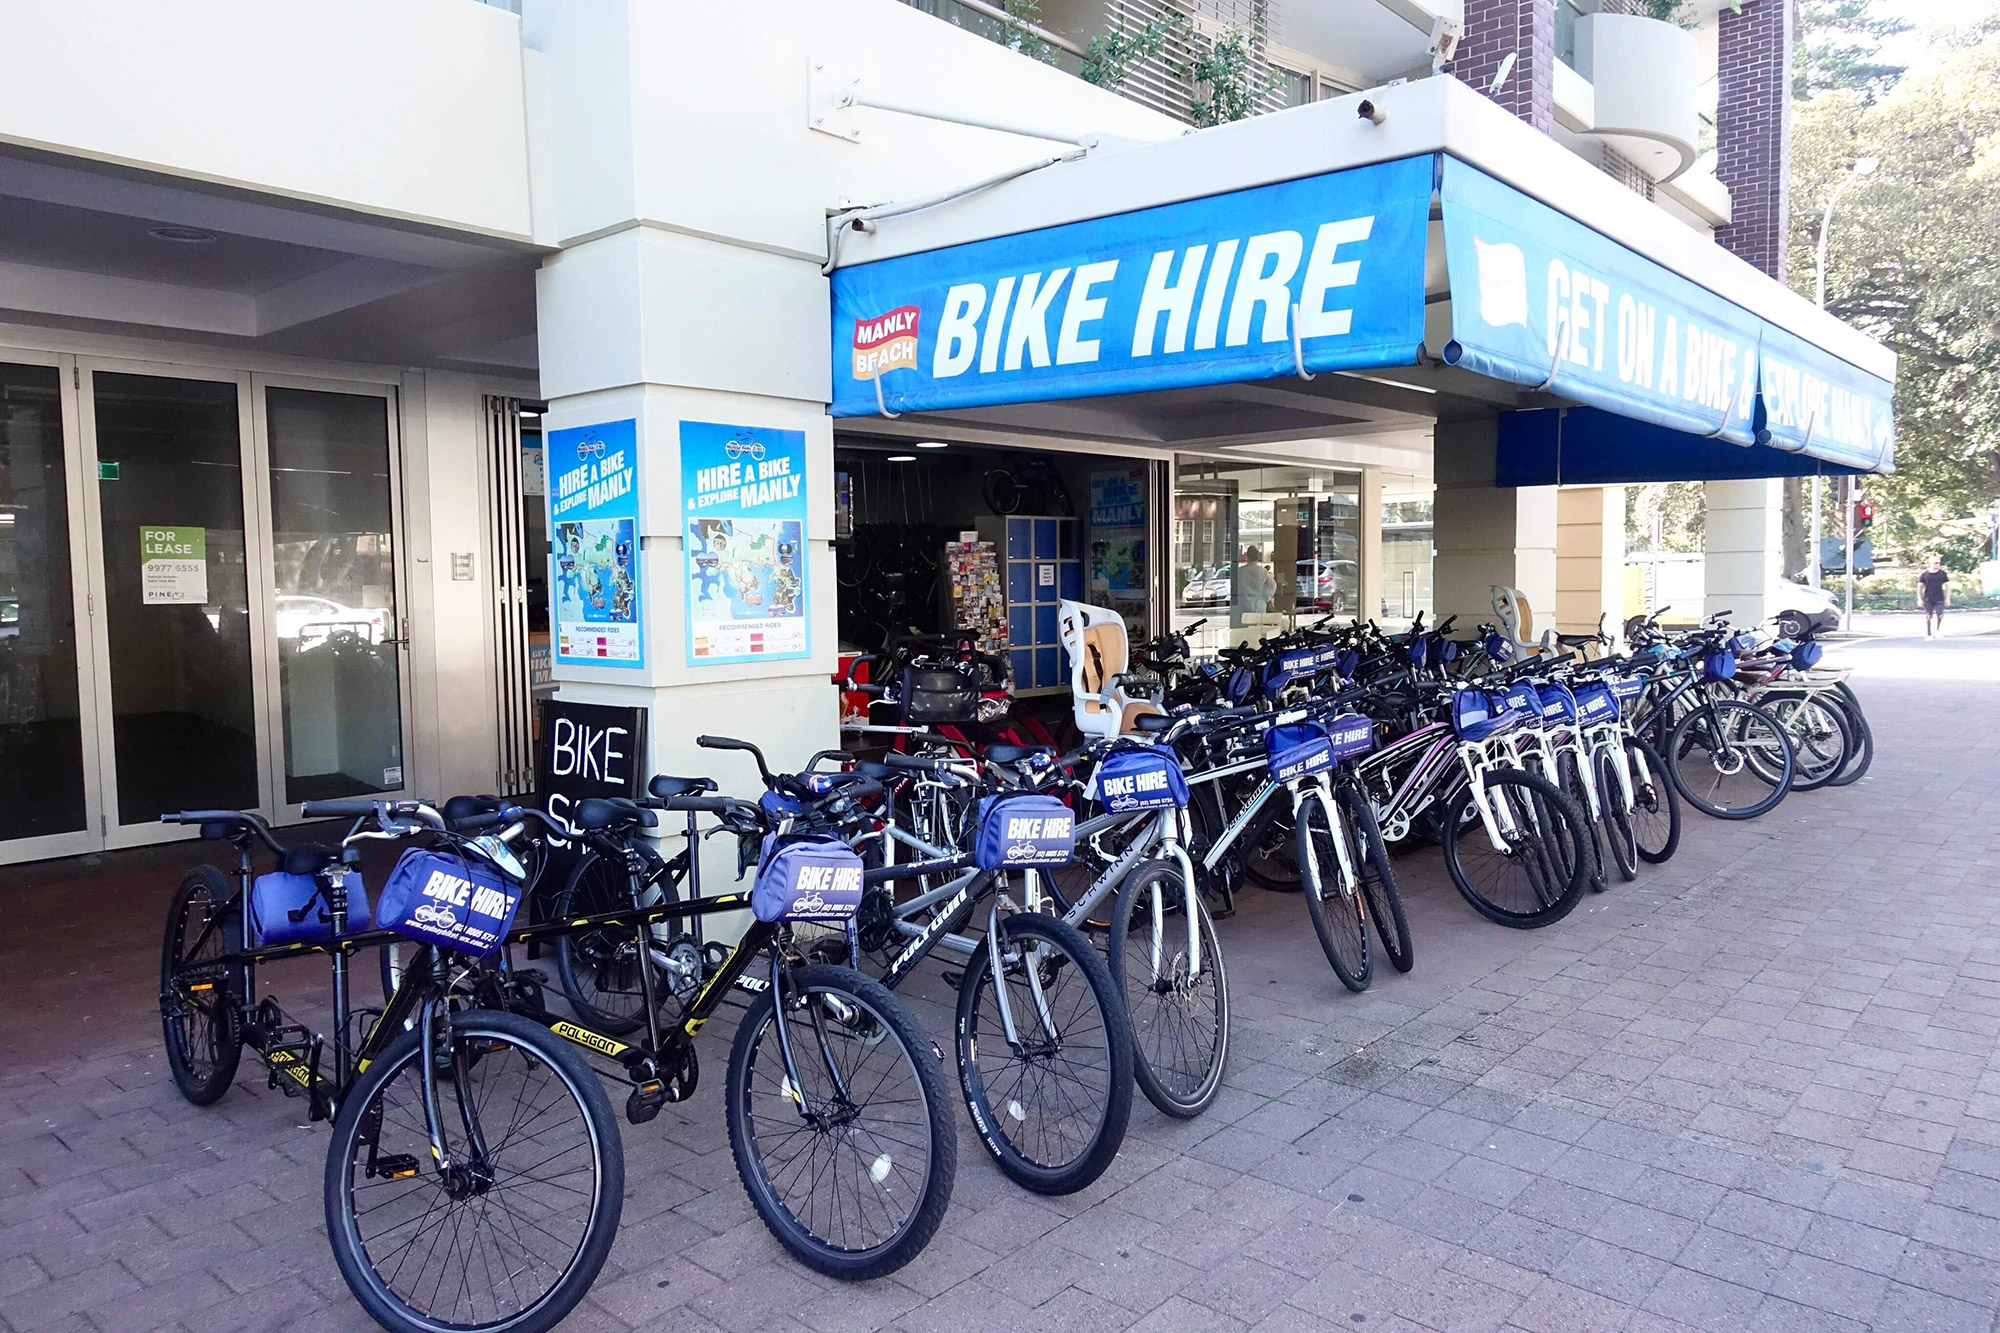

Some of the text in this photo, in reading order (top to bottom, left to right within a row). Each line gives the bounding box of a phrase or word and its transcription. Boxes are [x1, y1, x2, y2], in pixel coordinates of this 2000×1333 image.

[933, 215, 1374, 378] BIKE HIRE
[857, 312, 916, 344] MANLY
[856, 341, 914, 372] BEACH
[1547, 259, 1609, 371] GET
[1618, 293, 1655, 389] ON
[1659, 315, 1678, 396] A
[1684, 323, 1736, 412] BIKE
[1738, 348, 1755, 420] &
[1763, 357, 1829, 436] EXPLORE
[559, 450, 624, 498] HIRE A BIKE
[697, 457, 790, 493] HIRE A BIKE
[553, 467, 633, 515] & EXPLORE MANLY
[687, 474, 801, 510] & EXPLORE MANLY
[1103, 483, 1137, 498] BIKE
[1092, 503, 1144, 523] MANLY
[145, 531, 176, 541] FOR
[146, 543, 192, 554] LEASE
[148, 564, 199, 572] 9977 6555
[719, 623, 764, 631] RECOMMENDED
[1283, 659, 1299, 670] BIKE
[1300, 657, 1314, 667] HIRE
[1587, 695, 1607, 713] HIRE
[1344, 727, 1369, 743] HIRE
[553, 717, 628, 784] BIKE
[1280, 762, 1304, 778] BIKE
[1305, 749, 1330, 769] HIRE
[1103, 770, 1168, 797] BIKE HIRE
[1007, 817, 1071, 839] BIKE HIRE
[422, 870, 475, 907] BIKE
[796, 866, 862, 890] BIKE HIRE
[1068, 844, 1133, 918] SCHWINN
[892, 887, 967, 974] POLYGON
[559, 1023, 616, 1053] POLYGON
